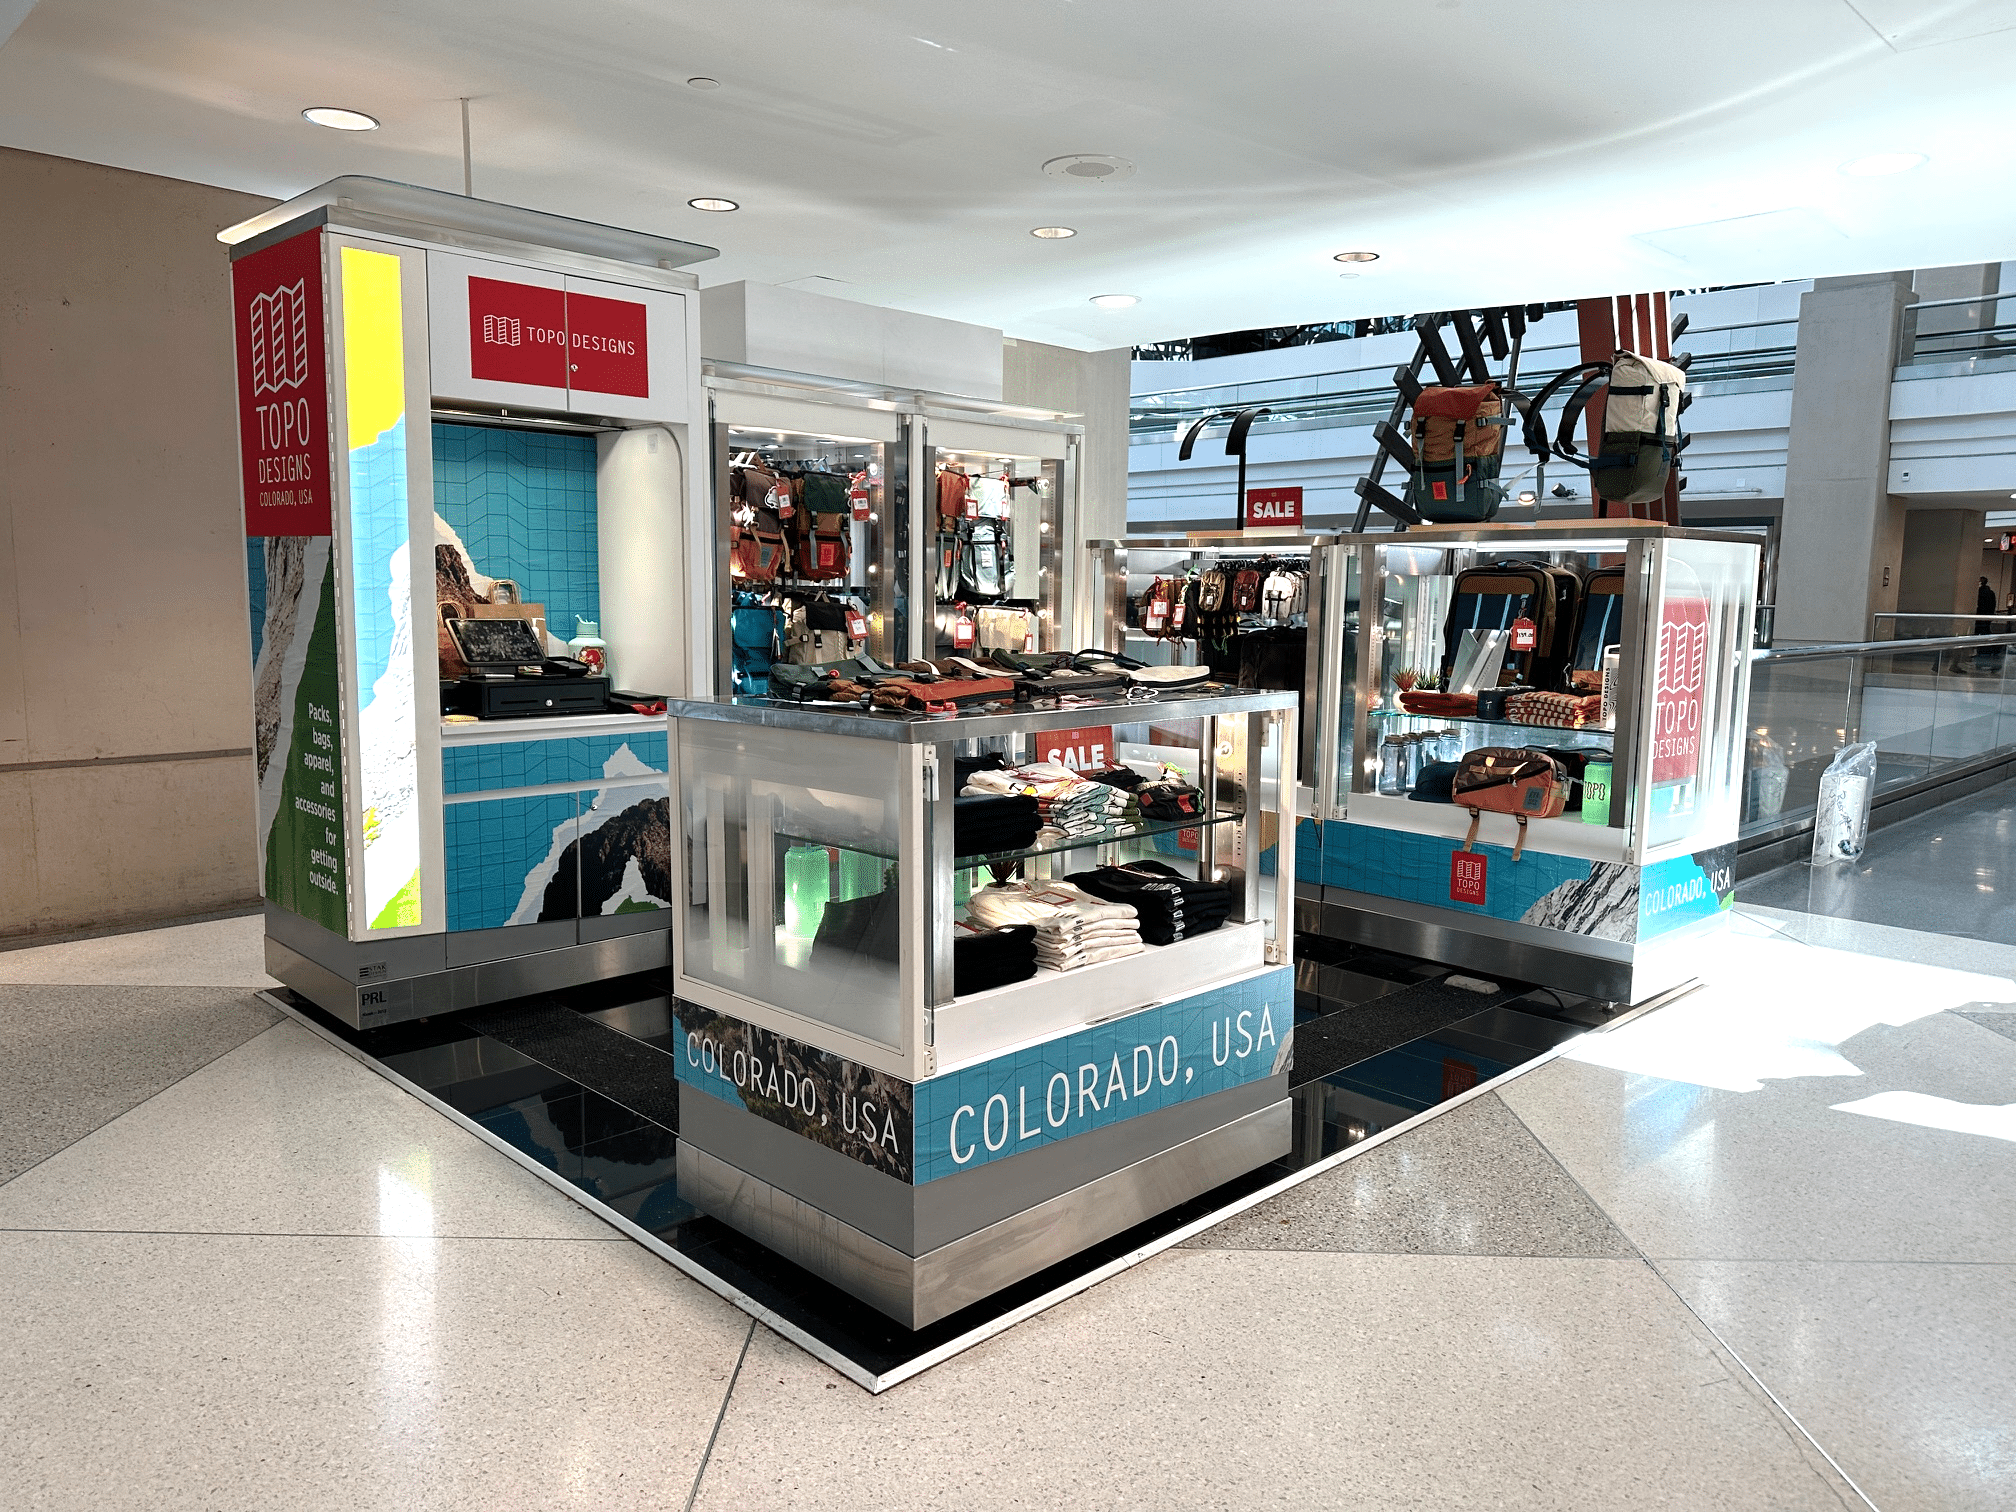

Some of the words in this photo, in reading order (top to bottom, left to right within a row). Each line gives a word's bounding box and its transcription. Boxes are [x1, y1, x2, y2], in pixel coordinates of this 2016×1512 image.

[526, 326, 566, 346] TOPO
[572, 333, 635, 355] DESIGNS
[255, 397, 310, 450] TOPO
[258, 453, 311, 484] DESIGNS
[260, 490, 297, 506] COLORADO,
[299, 489, 313, 504] USA
[1253, 501, 1295, 519] SALE
[308, 702, 332, 726] Packs,
[1656, 699, 1699, 735] TOPO
[312, 727, 333, 752] bags,
[1652, 735, 1696, 760] DESIGNS
[304, 752, 334, 776] apparel,
[1047, 744, 1106, 772] SALE
[320, 781, 335, 798] and
[1584, 781, 1605, 801] TOPO
[295, 796, 336, 822] accessories
[325, 827, 337, 846] for
[310, 849, 338, 874] getting
[309, 871, 339, 895] outside.
[1458, 878, 1480, 891] TOPO
[1645, 876, 1706, 916] COLORADO,
[1711, 866, 1730, 893] USA
[362, 991, 387, 1006] PRL
[686, 1031, 828, 1127] COLORADO,
[842, 1092, 899, 1154] USA
[950, 1035, 1194, 1164] COLORADO,
[1212, 1001, 1276, 1067] USA
